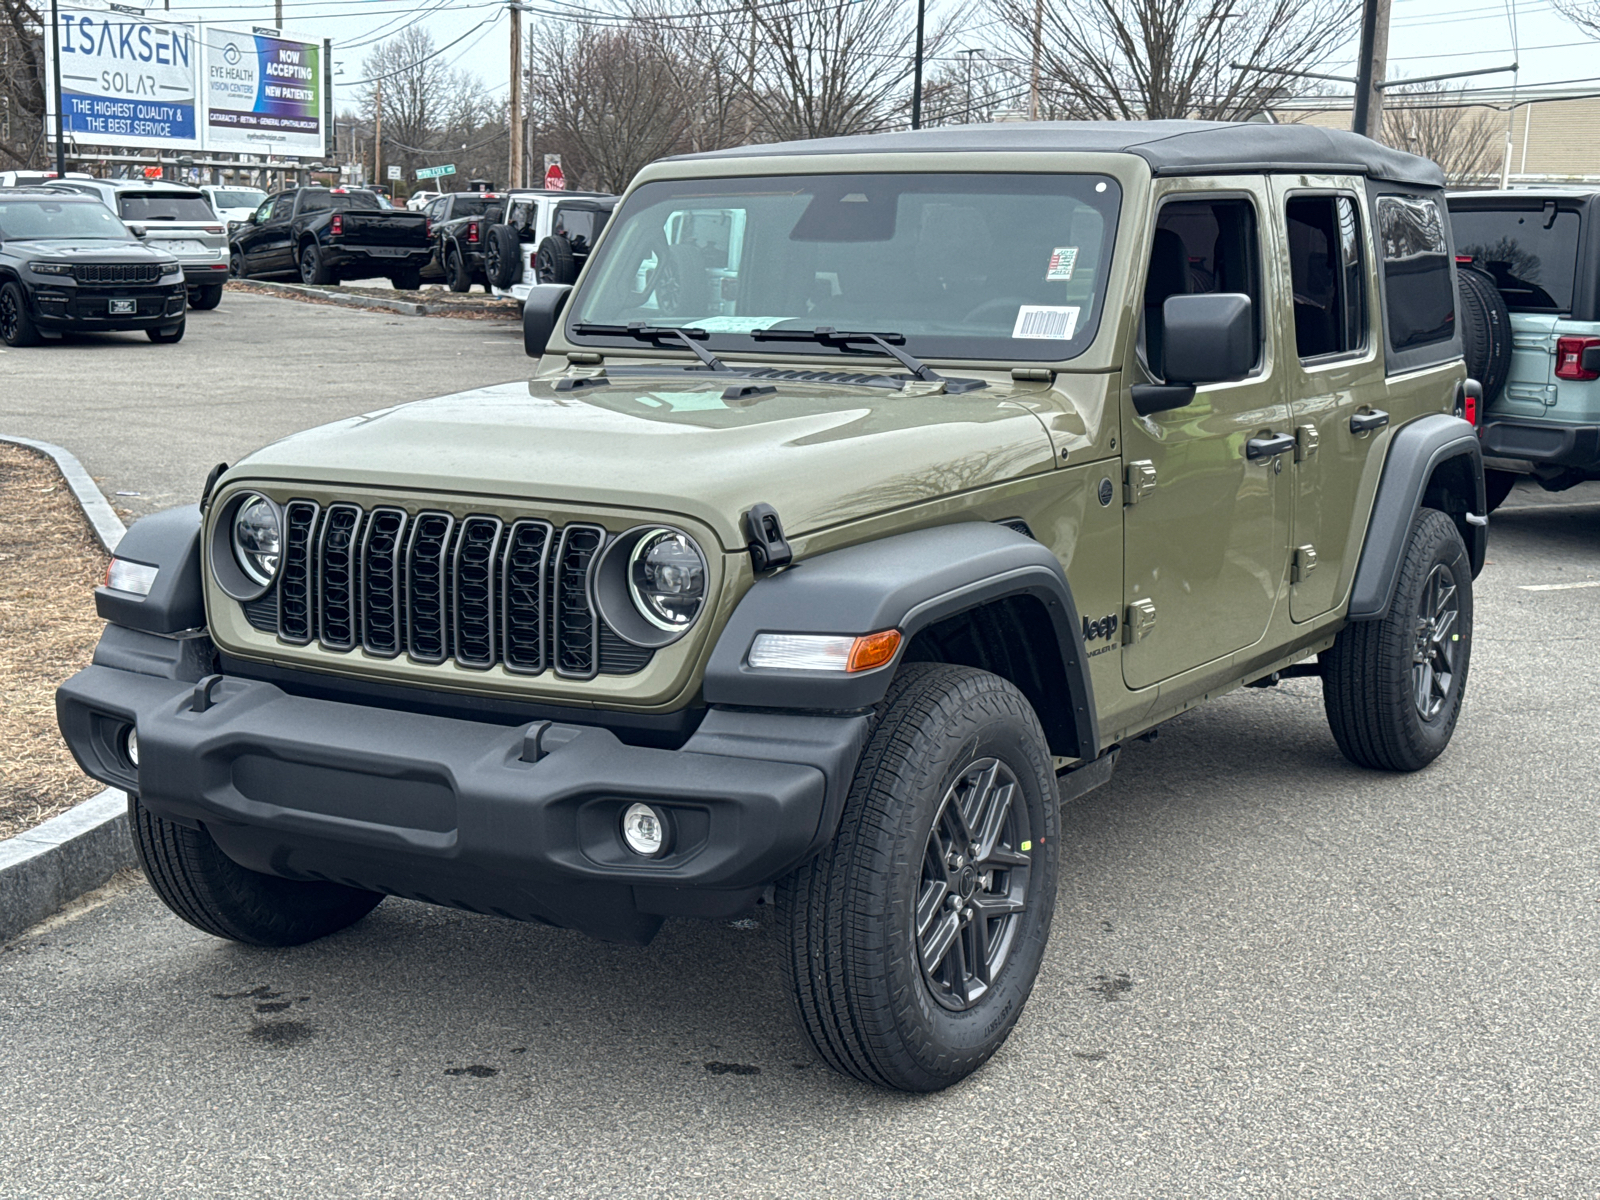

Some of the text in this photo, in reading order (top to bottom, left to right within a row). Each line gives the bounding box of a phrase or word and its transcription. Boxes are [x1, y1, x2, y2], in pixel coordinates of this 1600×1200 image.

[60, 13, 189, 68] ISAKSEN
[279, 49, 300, 64] NOW
[210, 65, 254, 81] EYE HEALTH
[266, 62, 313, 80] ACCEPTING
[101, 70, 156, 96] SOLAR
[210, 82, 254, 94] VISION CENTERS
[264, 85, 281, 97] NEW
[281, 86, 314, 101] PATIENTS!
[71, 98, 183, 122] THE HIGHEST QUALITY &
[86, 117, 172, 137] THE BEST SERVICE
[1082, 612, 1118, 642] Jeep
[1086, 644, 1111, 658] ANGLER
